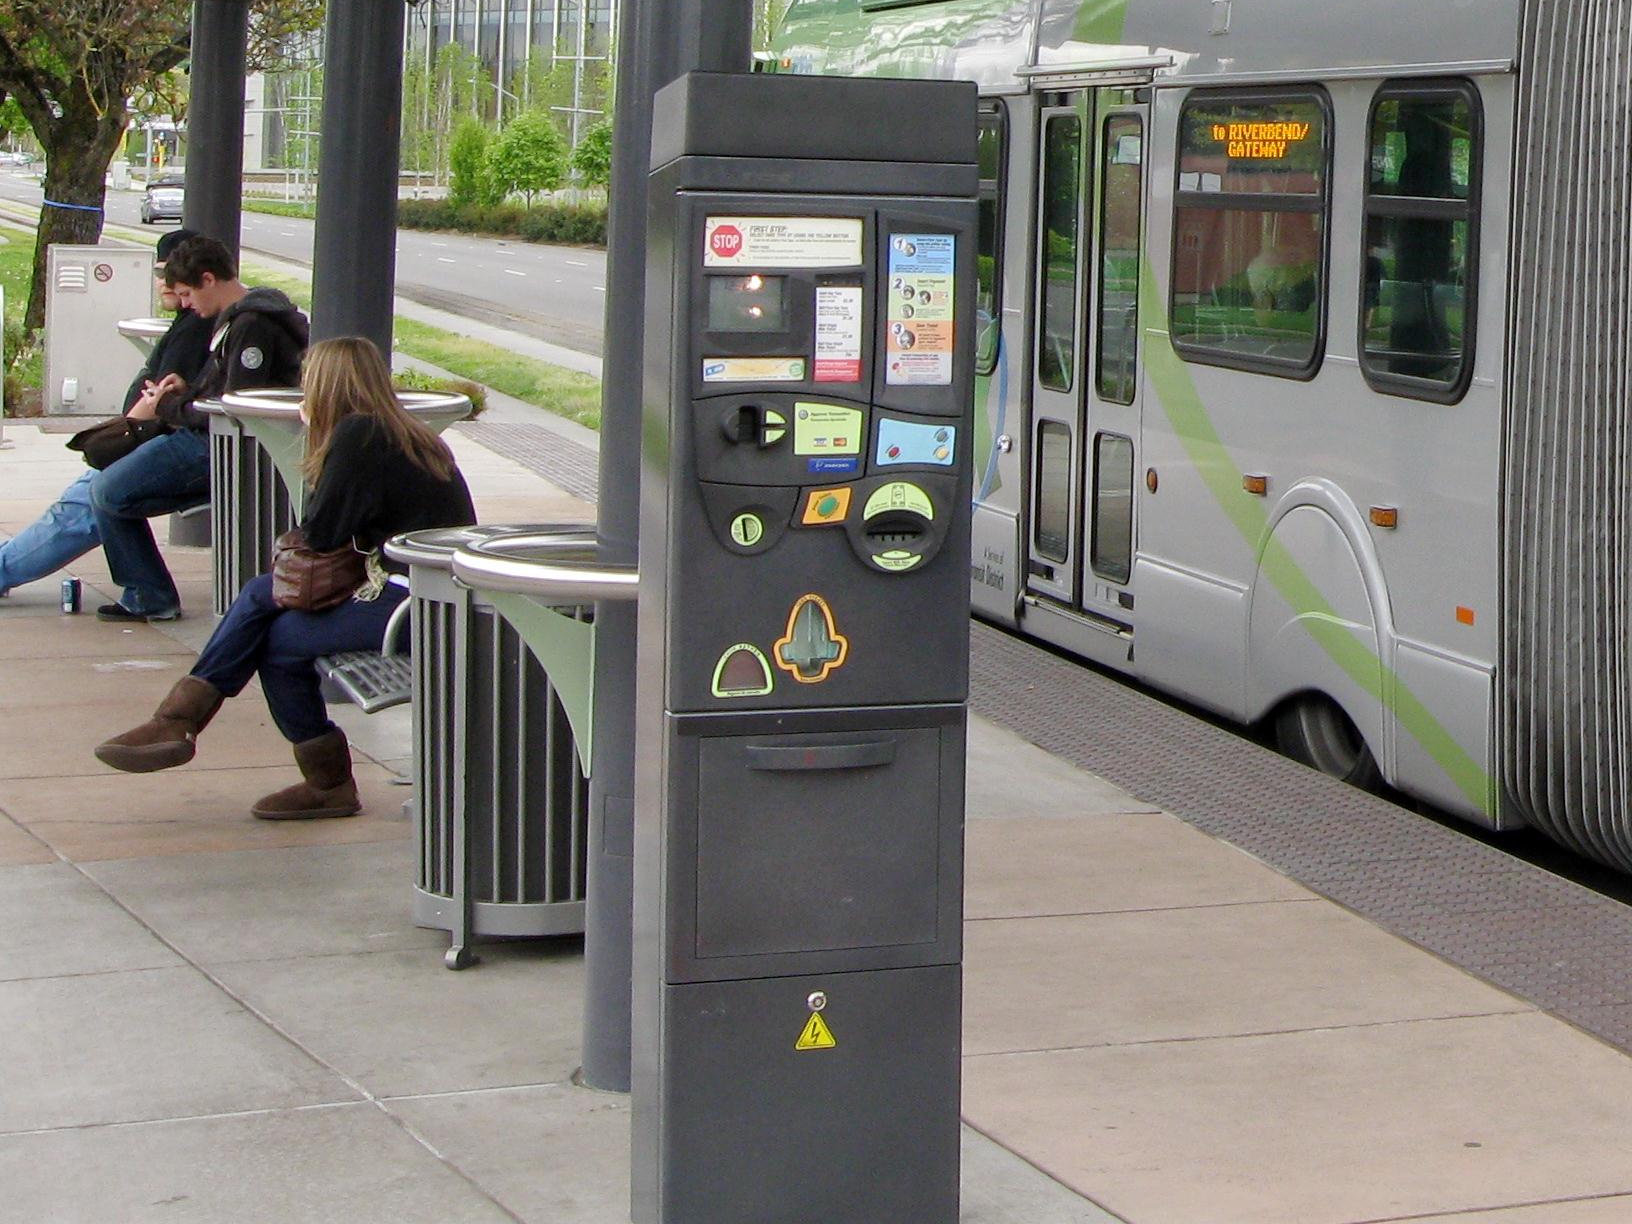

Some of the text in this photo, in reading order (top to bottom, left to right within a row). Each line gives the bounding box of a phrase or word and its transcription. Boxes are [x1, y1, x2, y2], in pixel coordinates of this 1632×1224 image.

[1212, 124, 1226, 140] to
[1228, 141, 1286, 158] GATEWAY
[713, 234, 739, 249] STOP
[894, 278, 902, 289] 2
[895, 323, 902, 335] 3
